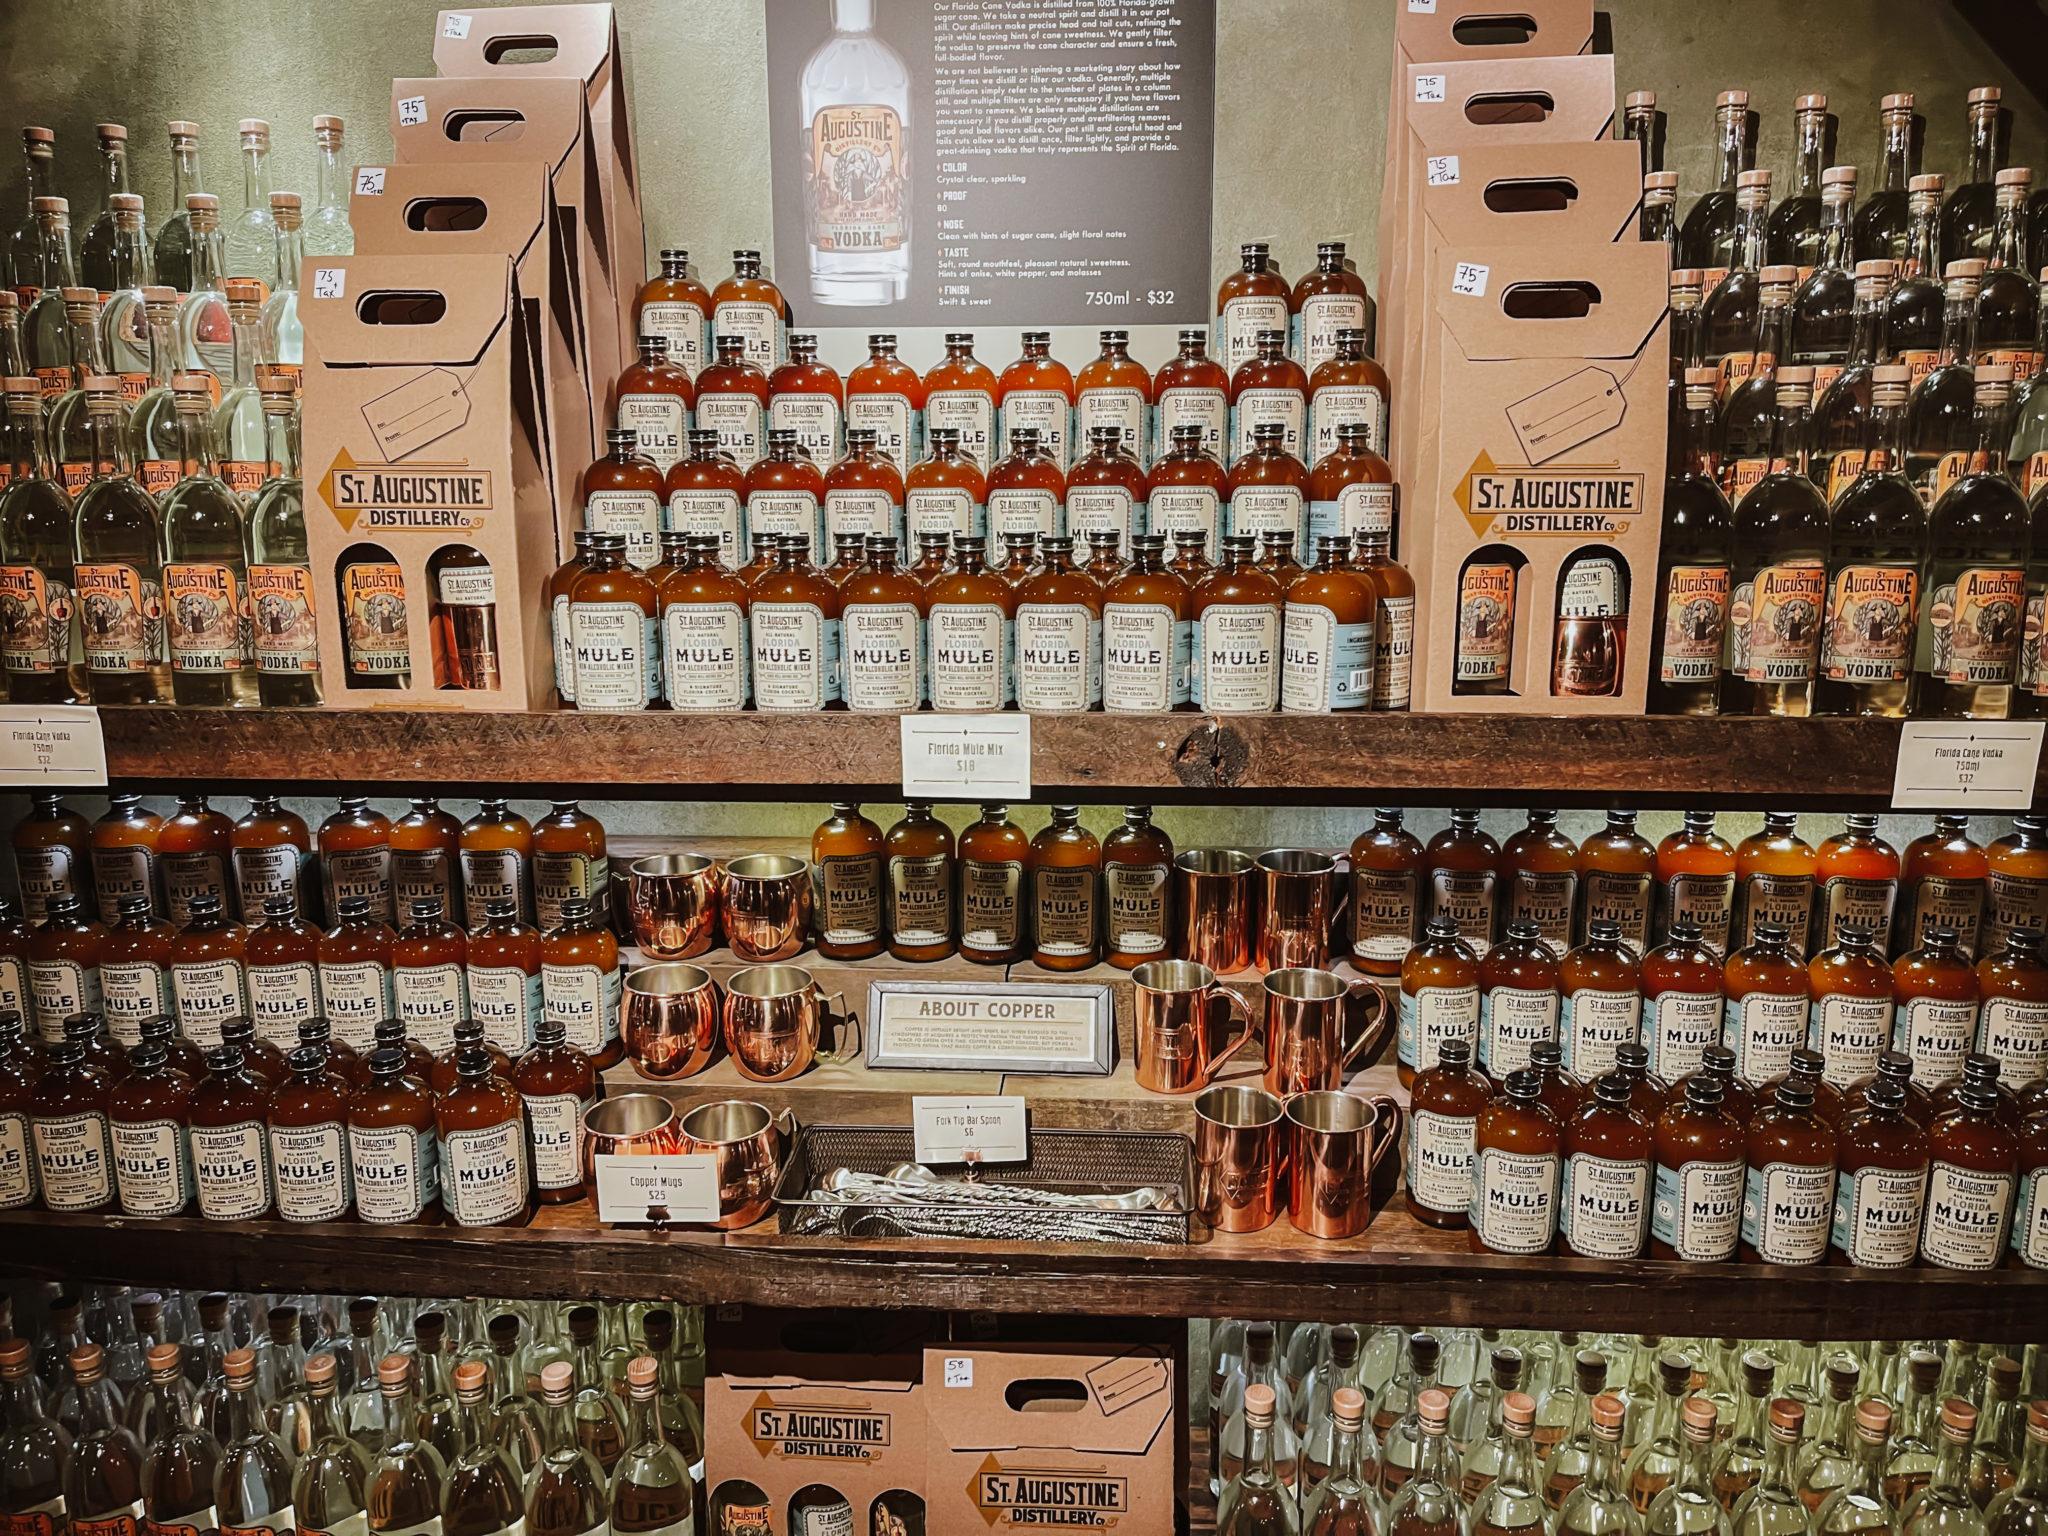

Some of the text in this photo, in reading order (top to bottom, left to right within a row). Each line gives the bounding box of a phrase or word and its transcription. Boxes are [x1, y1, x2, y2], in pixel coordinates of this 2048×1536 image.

[934, 17, 1181, 30] still. Our distillers make precise head and tail cuts, refining the
[934, 32, 953, 43] spirit
[956, 32, 976, 40] while
[979, 31, 1007, 42] leaving
[1011, 31, 1028, 39] hints
[1031, 31, 1040, 39] of
[1064, 30, 1107, 38] sweetness.
[1109, 29, 1123, 37] We
[1126, 29, 1150, 39] gently
[1153, 28, 1172, 36] filter
[820, 113, 893, 141] AUGUSTINE
[943, 163, 967, 172] COLOR
[937, 173, 1026, 184] Crystal clear, sparkling
[943, 191, 968, 200] PROOF
[944, 220, 964, 229] NOSE
[833, 230, 884, 247] VODKA
[937, 231, 959, 239] Clean
[963, 231, 978, 239] with
[981, 231, 998, 239] hints
[1001, 231, 1009, 239] of
[1012, 233, 1033, 241] sugar
[1059, 230, 1080, 241] slight
[1082, 230, 1103, 239] floral
[1106, 230, 1126, 238] notes
[944, 248, 969, 257] TASTE
[938, 258, 1130, 269] Soft, round mouthfeel, pleasant natural sweetness.
[938, 268, 1101, 278] Hints of anise, white pepper, and molasses
[944, 286, 970, 295] FINISH
[1086, 291, 1130, 305] 750ml
[1147, 290, 1175, 305] $32
[938, 297, 991, 305] Swift & sweet
[372, 475, 484, 504] AUGUSTINE
[1510, 478, 1634, 508] AUGUSTINE
[370, 510, 460, 525] DISTILLERY
[1506, 515, 1605, 530] DISTILLERY
[75, 569, 130, 589] AUGUSTINE
[167, 570, 228, 589] AUGUSTINE
[1764, 572, 1824, 594] AUGUSTINE
[1843, 572, 1913, 594] AUGUSTINE
[861, 639, 901, 648] FLORIDA
[578, 648, 634, 661] MULE
[676, 648, 734, 662] MULE
[757, 648, 811, 662] MULE
[854, 649, 911, 663] MULE
[938, 649, 994, 663] MULE
[1024, 649, 1080, 663] MULE
[1107, 648, 1161, 663] MULE
[1211, 649, 1270, 665] MULE
[89, 656, 128, 668] VODKA
[181, 656, 222, 668] VODKA
[1766, 664, 1808, 677] VODKA
[1846, 663, 1892, 678] VODKA
[12, 731, 71, 741] Florida Cane Vodka
[33, 743, 54, 752] 750ml
[928, 743, 1003, 755] Florida Mule Mix
[1934, 748, 2003, 759] Florida Cane Vodka
[1956, 761, 1979, 771] 750ml
[830, 888, 877, 902] MULE
[1113, 897, 1160, 911] MULE
[181, 992, 234, 1010] MULE
[919, 1001, 1056, 1019] ABOUT COPPER
[1582, 1025, 1634, 1041] MULE
[936, 1115, 1001, 1125] Fork Tip Bar Spoon
[42, 1149, 99, 1168] MULE
[200, 1159, 257, 1177] MULE
[459, 1158, 516, 1182] MULE
[630, 1176, 683, 1187] Copper Mugs
[1490, 1188, 1548, 1206] MULE
[1580, 1193, 1639, 1213] MULE
[1935, 1201, 1999, 1224] MULE
[786, 1413, 883, 1441] AUGUSTINE
[784, 1441, 862, 1457] DISTILLERY
[1014, 1477, 1119, 1507] AUGUSTINE
[1012, 1508, 1097, 1525] DISTILLERY
